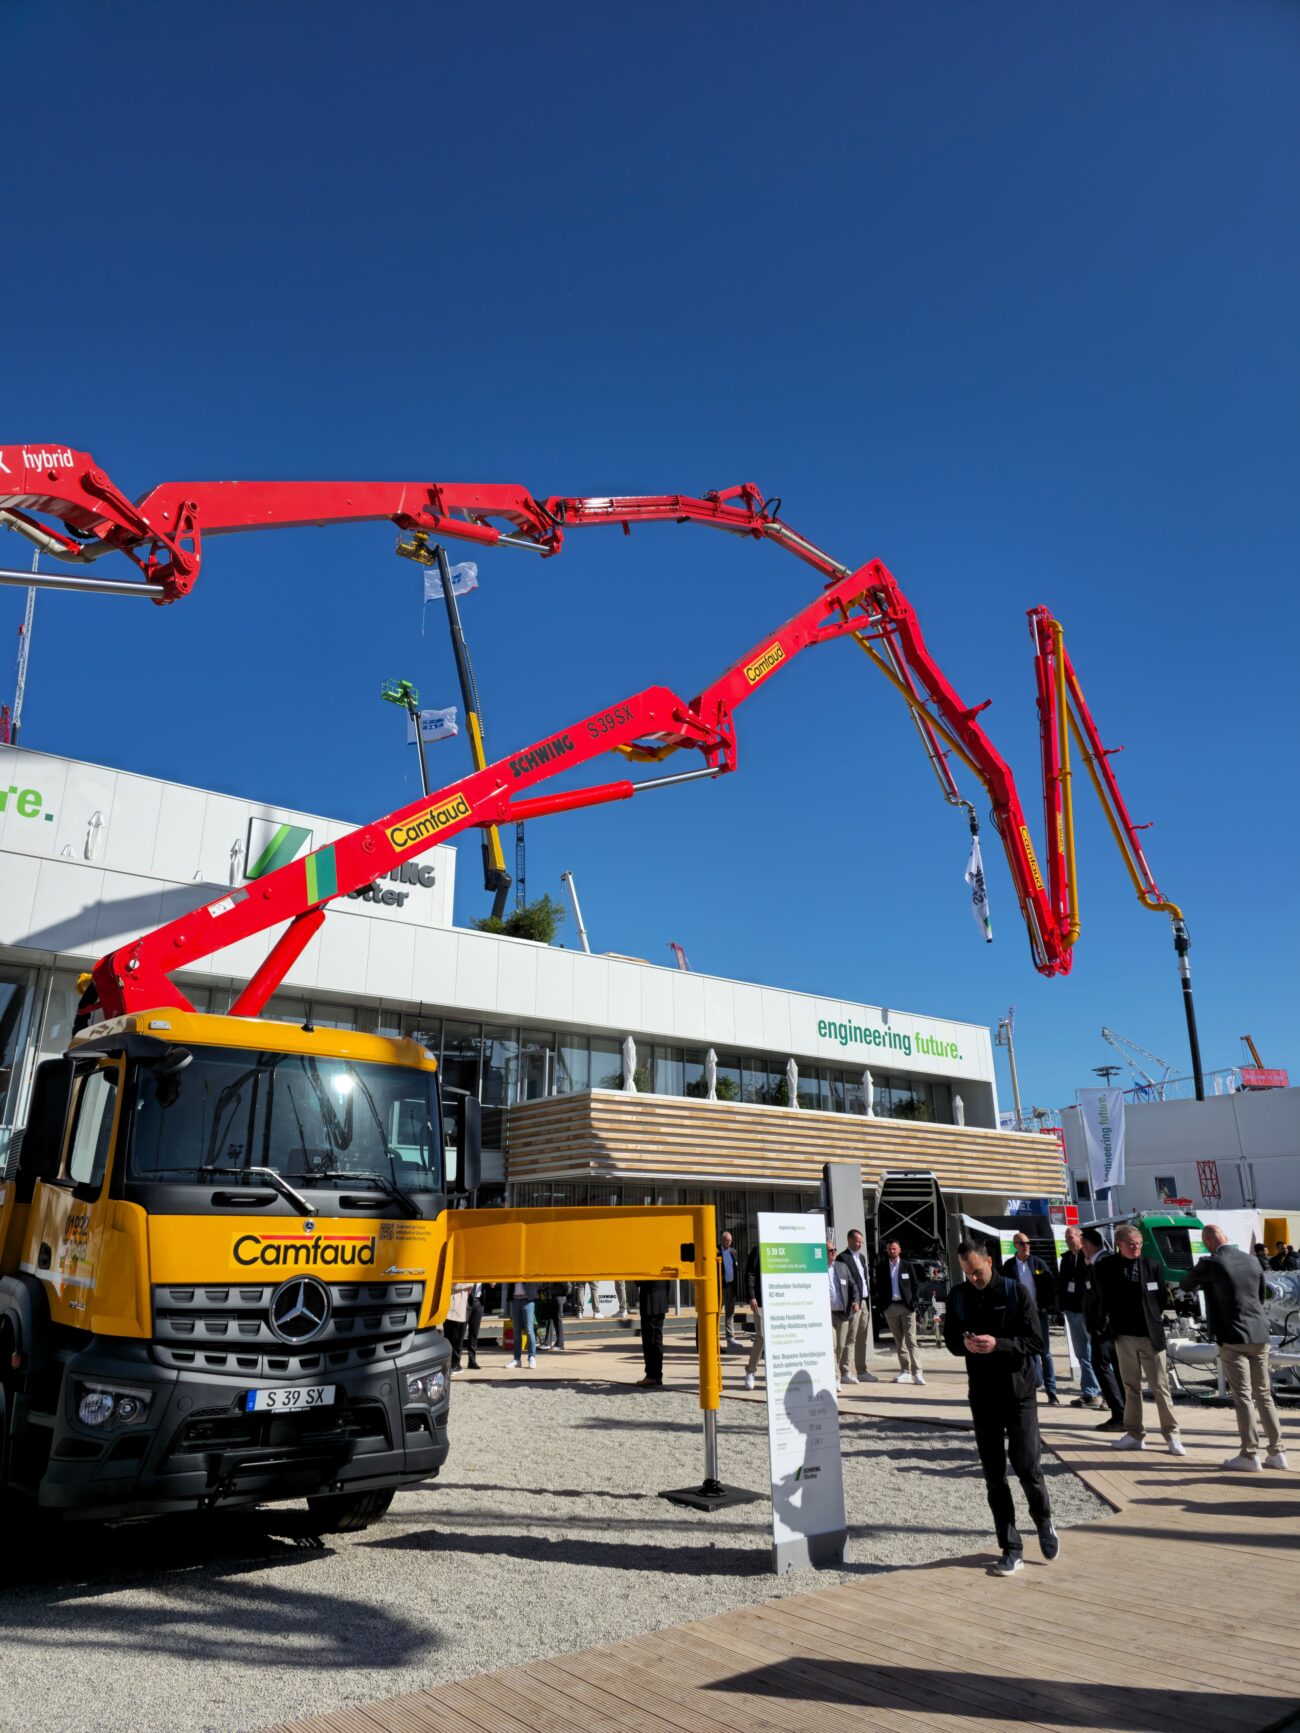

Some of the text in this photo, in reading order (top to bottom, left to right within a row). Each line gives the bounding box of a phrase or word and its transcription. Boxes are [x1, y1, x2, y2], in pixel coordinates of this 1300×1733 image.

[22, 449, 74, 472] hybrid
[746, 643, 784, 682] Camfaud
[508, 734, 575, 778] SCHWING
[390, 794, 470, 848] Camfaud
[380, 861, 436, 888] ING
[1021, 827, 1043, 889] Camfaud
[818, 1019, 963, 1060] engineering future.
[232, 1234, 376, 1266] Camfaud
[266, 1388, 325, 1407] S 39 SX
